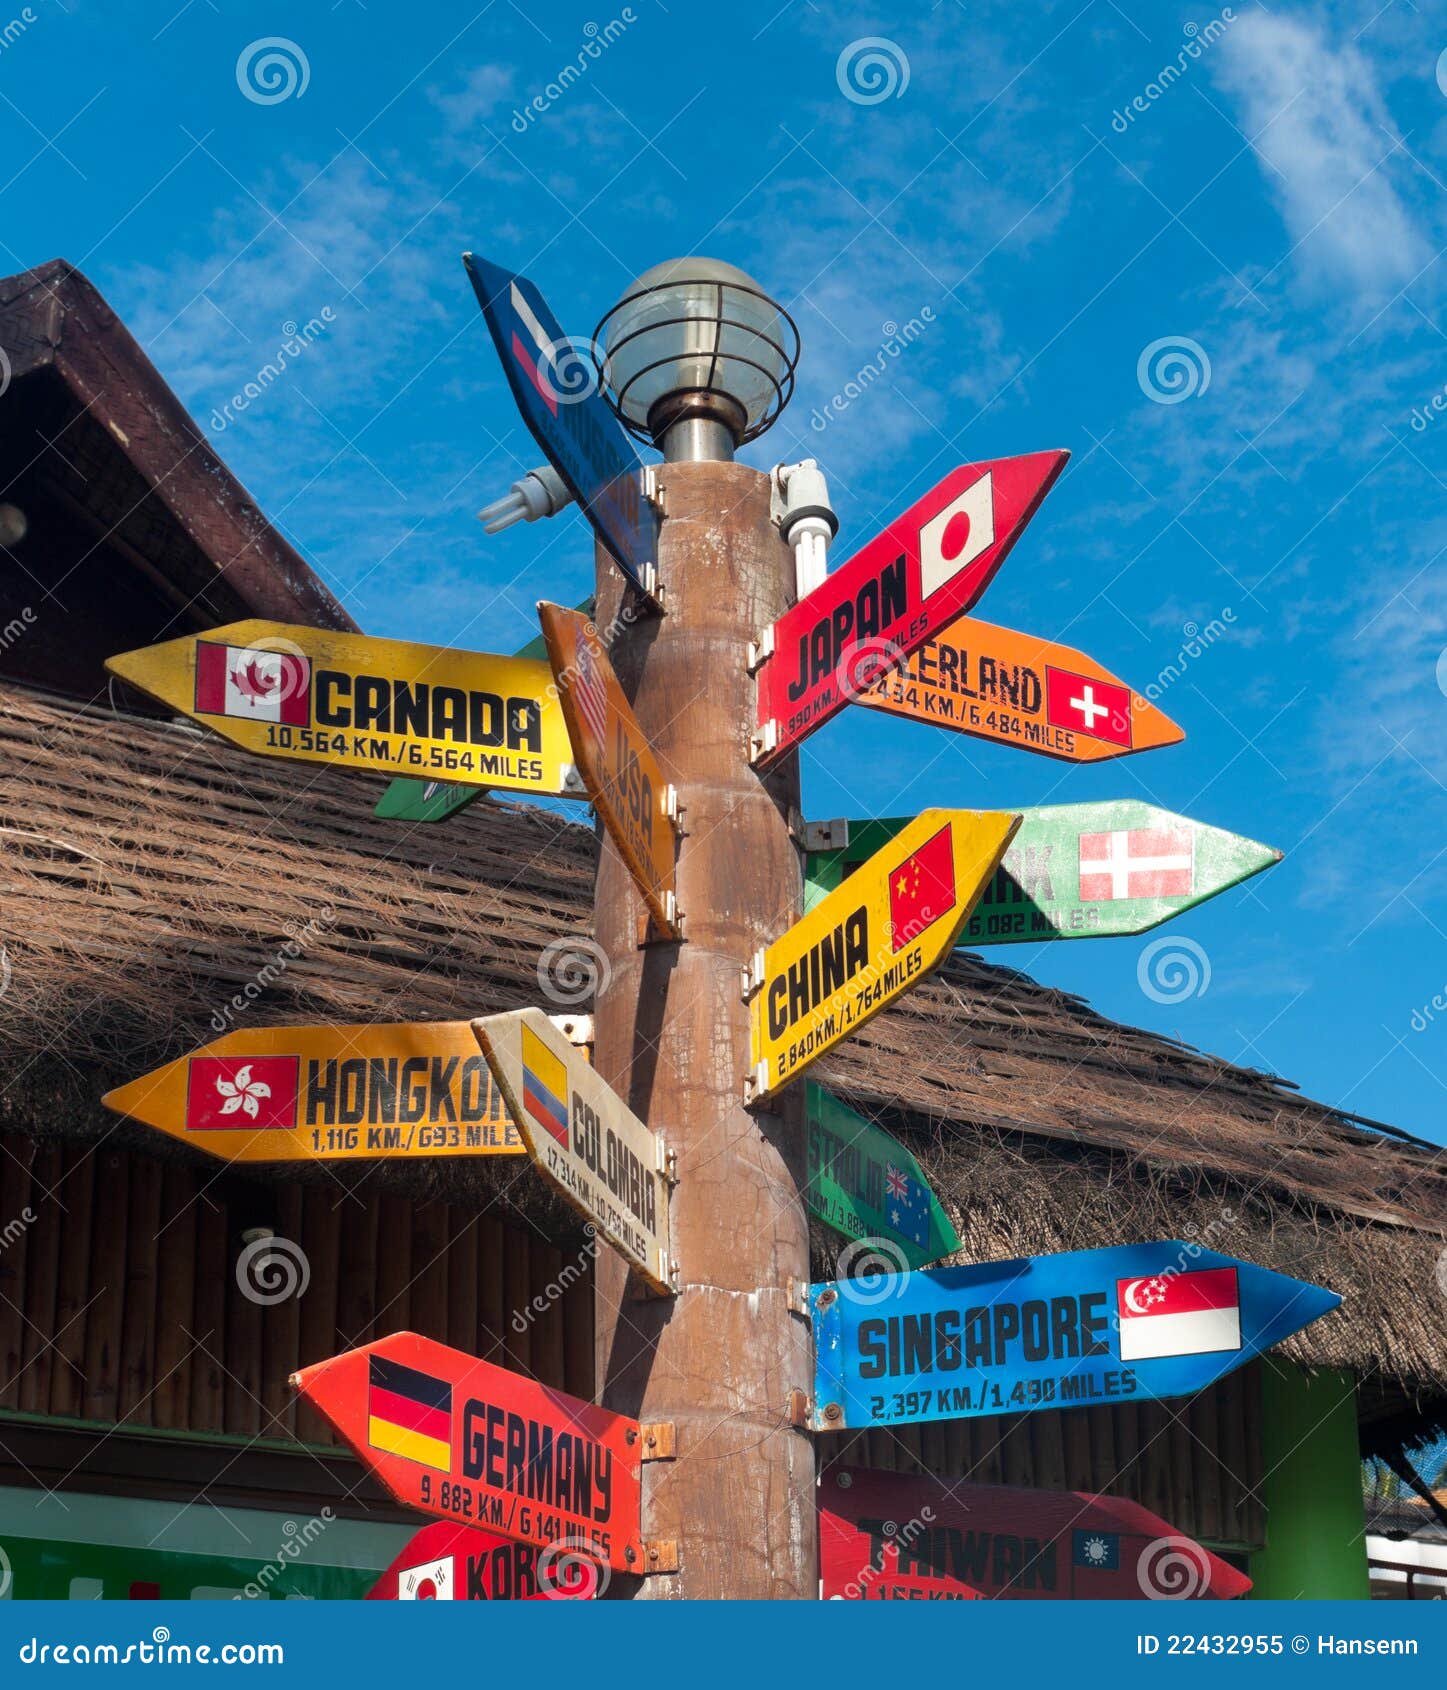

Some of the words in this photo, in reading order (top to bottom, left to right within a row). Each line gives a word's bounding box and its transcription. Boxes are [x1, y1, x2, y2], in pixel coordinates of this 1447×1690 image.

[788, 554, 907, 702] JAPAN
[266, 726, 349, 756] 10,564
[480, 754, 543, 781] MILES
[316, 670, 542, 753] CANADA
[1024, 721, 1075, 753] MILES
[617, 719, 652, 848] USA
[768, 905, 869, 1042] CHINA
[778, 1034, 814, 1076] 2,840
[883, 947, 922, 995] MILES
[466, 1125, 525, 1147] MILE
[572, 1090, 656, 1238] COLOMBIA
[808, 1119, 882, 1212] STRALIA
[622, 1221, 647, 1262] MILES
[858, 1291, 1109, 1380] SINGAPORE
[871, 1390, 933, 1419] 2,397
[1061, 1369, 1137, 1400] MILES
[462, 1398, 613, 1523] GERMANY
[565, 1522, 611, 1560] MILES
[857, 1518, 1057, 1592] TAIWAN
